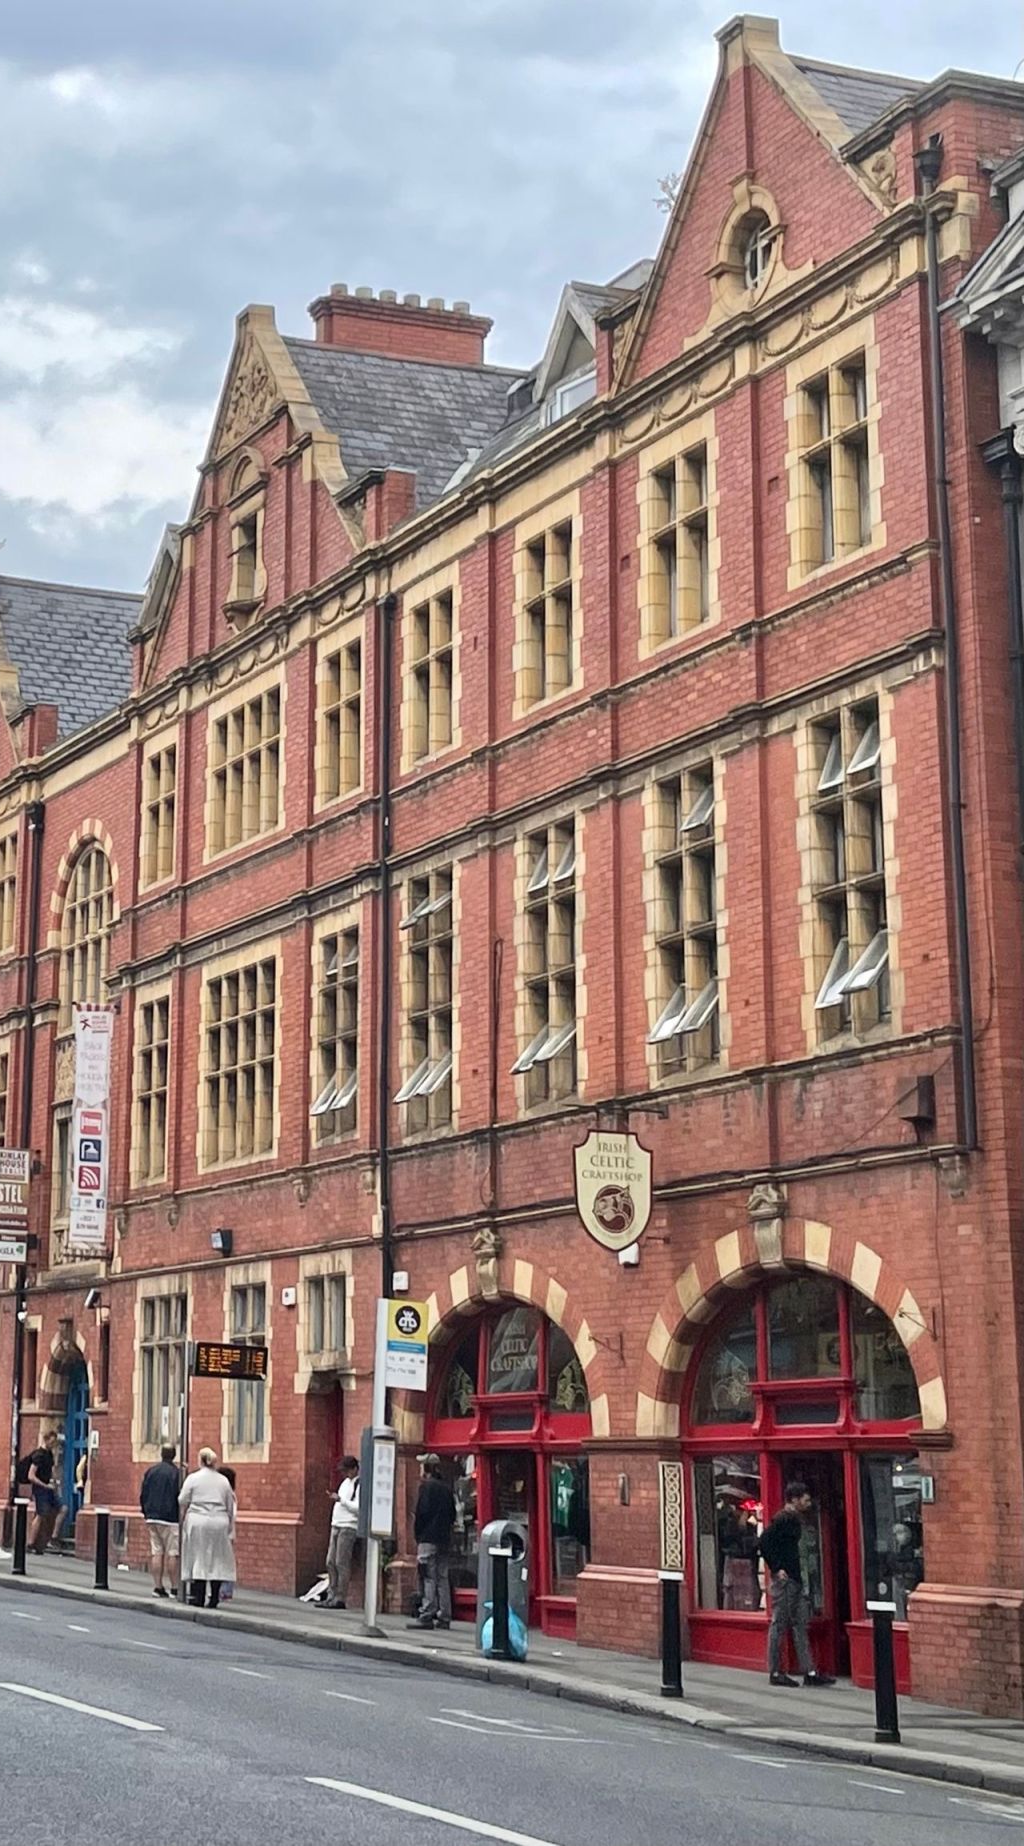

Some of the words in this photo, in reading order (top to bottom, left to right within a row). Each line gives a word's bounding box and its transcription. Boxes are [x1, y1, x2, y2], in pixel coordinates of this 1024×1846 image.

[598, 1142, 628, 1154] IRISH
[0, 1151, 26, 1160] KINLAY
[0, 1160, 26, 1169] HOUSE
[590, 1155, 636, 1169] CELTIC
[581, 1169, 643, 1182] CRAFTSHOP
